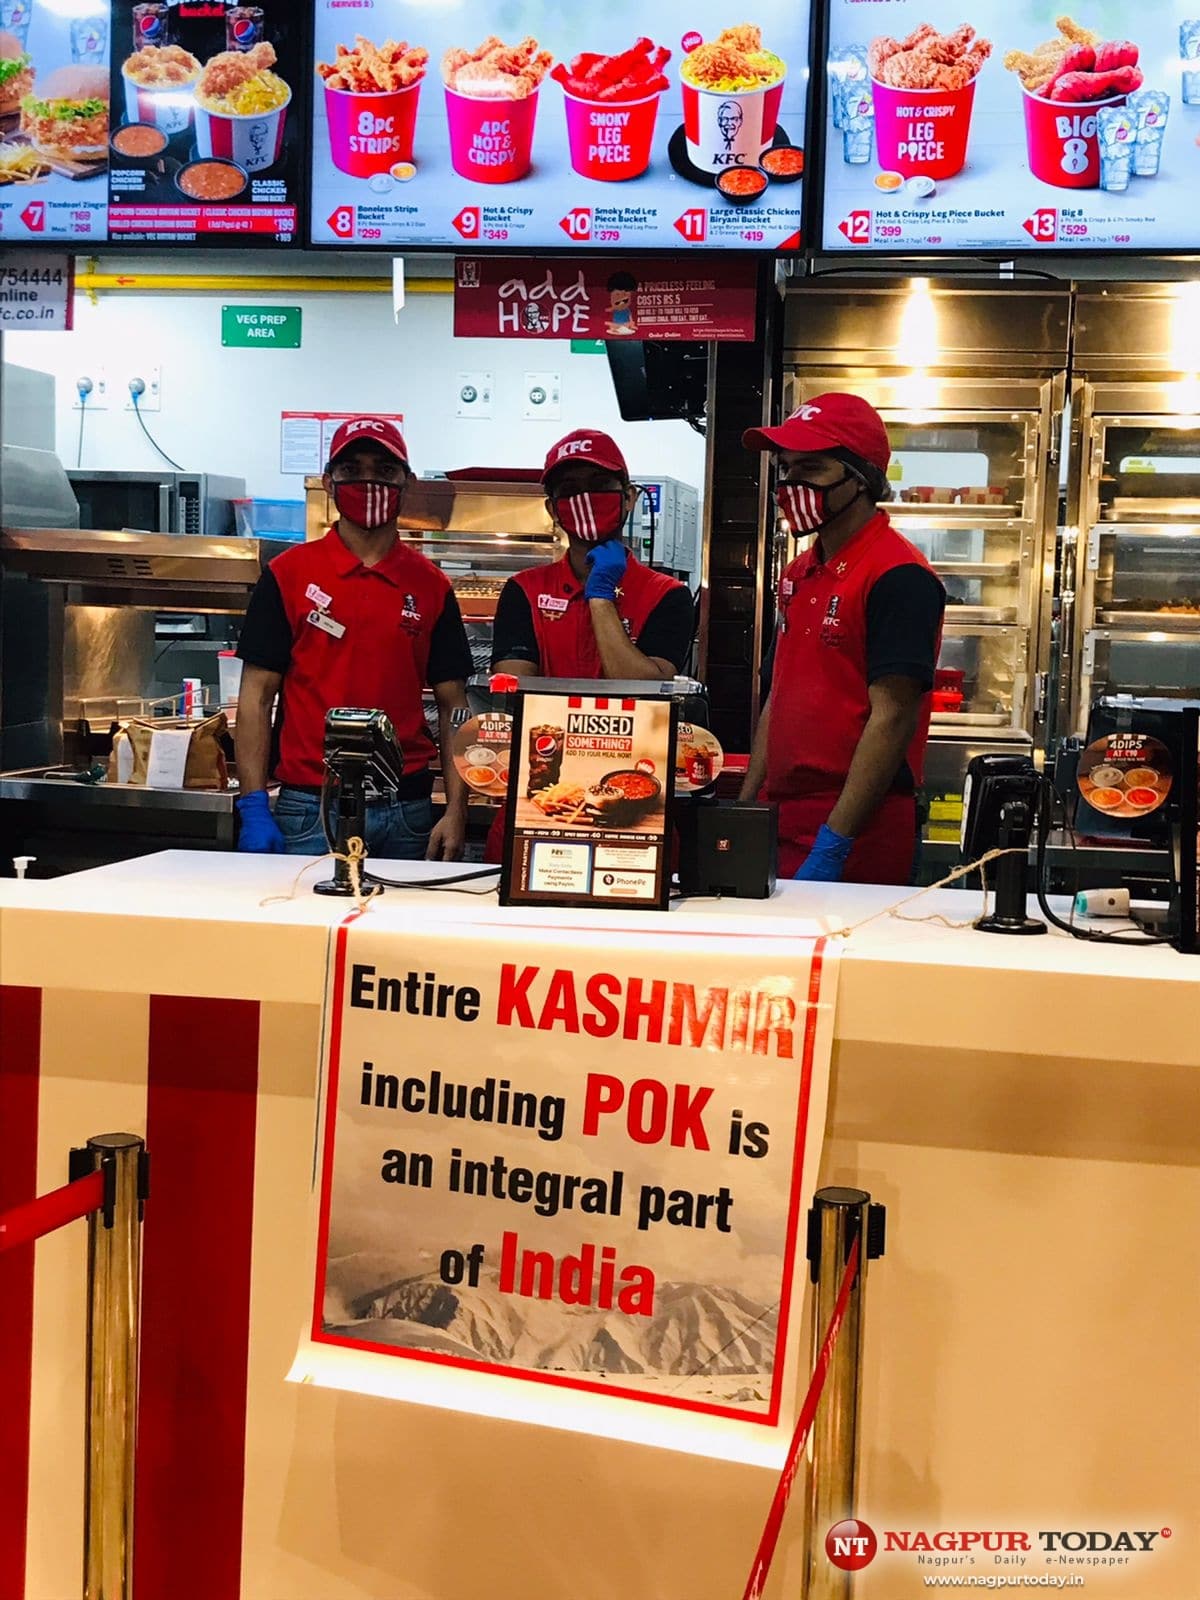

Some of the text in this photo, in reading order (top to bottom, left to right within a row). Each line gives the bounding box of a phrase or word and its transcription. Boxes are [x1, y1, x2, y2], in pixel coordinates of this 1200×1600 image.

[590, 112, 630, 126] SMOKY
[896, 106, 914, 118] HOT
[923, 105, 956, 118] CRISPY
[358, 111, 394, 136] 8PC
[480, 120, 510, 136] 4PC
[908, 122, 934, 140] LEG
[1056, 115, 1097, 138] BIG
[473, 134, 501, 150] HOT
[598, 128, 621, 144] LEG
[349, 136, 400, 154] STRIPS
[468, 147, 516, 166] CRISPY
[712, 154, 746, 164] KFC
[1061, 138, 1089, 174] 8
[28, 206, 43, 226] 7
[394, 206, 418, 214] Strips
[507, 206, 534, 216] Crispy
[595, 208, 623, 216] Smoky
[642, 208, 658, 216] Leg
[710, 208, 734, 216] Large
[902, 210, 930, 220] Crispy
[932, 210, 948, 218] Leg
[1062, 210, 1076, 218] Big
[336, 211, 351, 232] 8
[461, 212, 476, 234] 9
[566, 213, 591, 234] 10
[682, 214, 703, 236] 11
[710, 216, 740, 224] Biryani
[842, 216, 870, 238] 12
[1029, 214, 1056, 236] 13
[498, 269, 590, 302] add
[637, 294, 681, 306] COSTS RS 5
[236, 314, 287, 324] VEG PREP
[246, 328, 276, 338] AREA
[345, 420, 384, 436] KFC
[557, 440, 592, 460] KFC
[401, 609, 422, 621] KFC
[822, 616, 840, 626] KFC
[569, 714, 631, 735] MISSED
[568, 736, 632, 750] SOMETHING?
[350, 963, 796, 1059] Entire KASHMIR
[360, 1062, 770, 1159] including POK is
[381, 1148, 734, 1233] an integral part
[439, 1231, 656, 1317] of India
